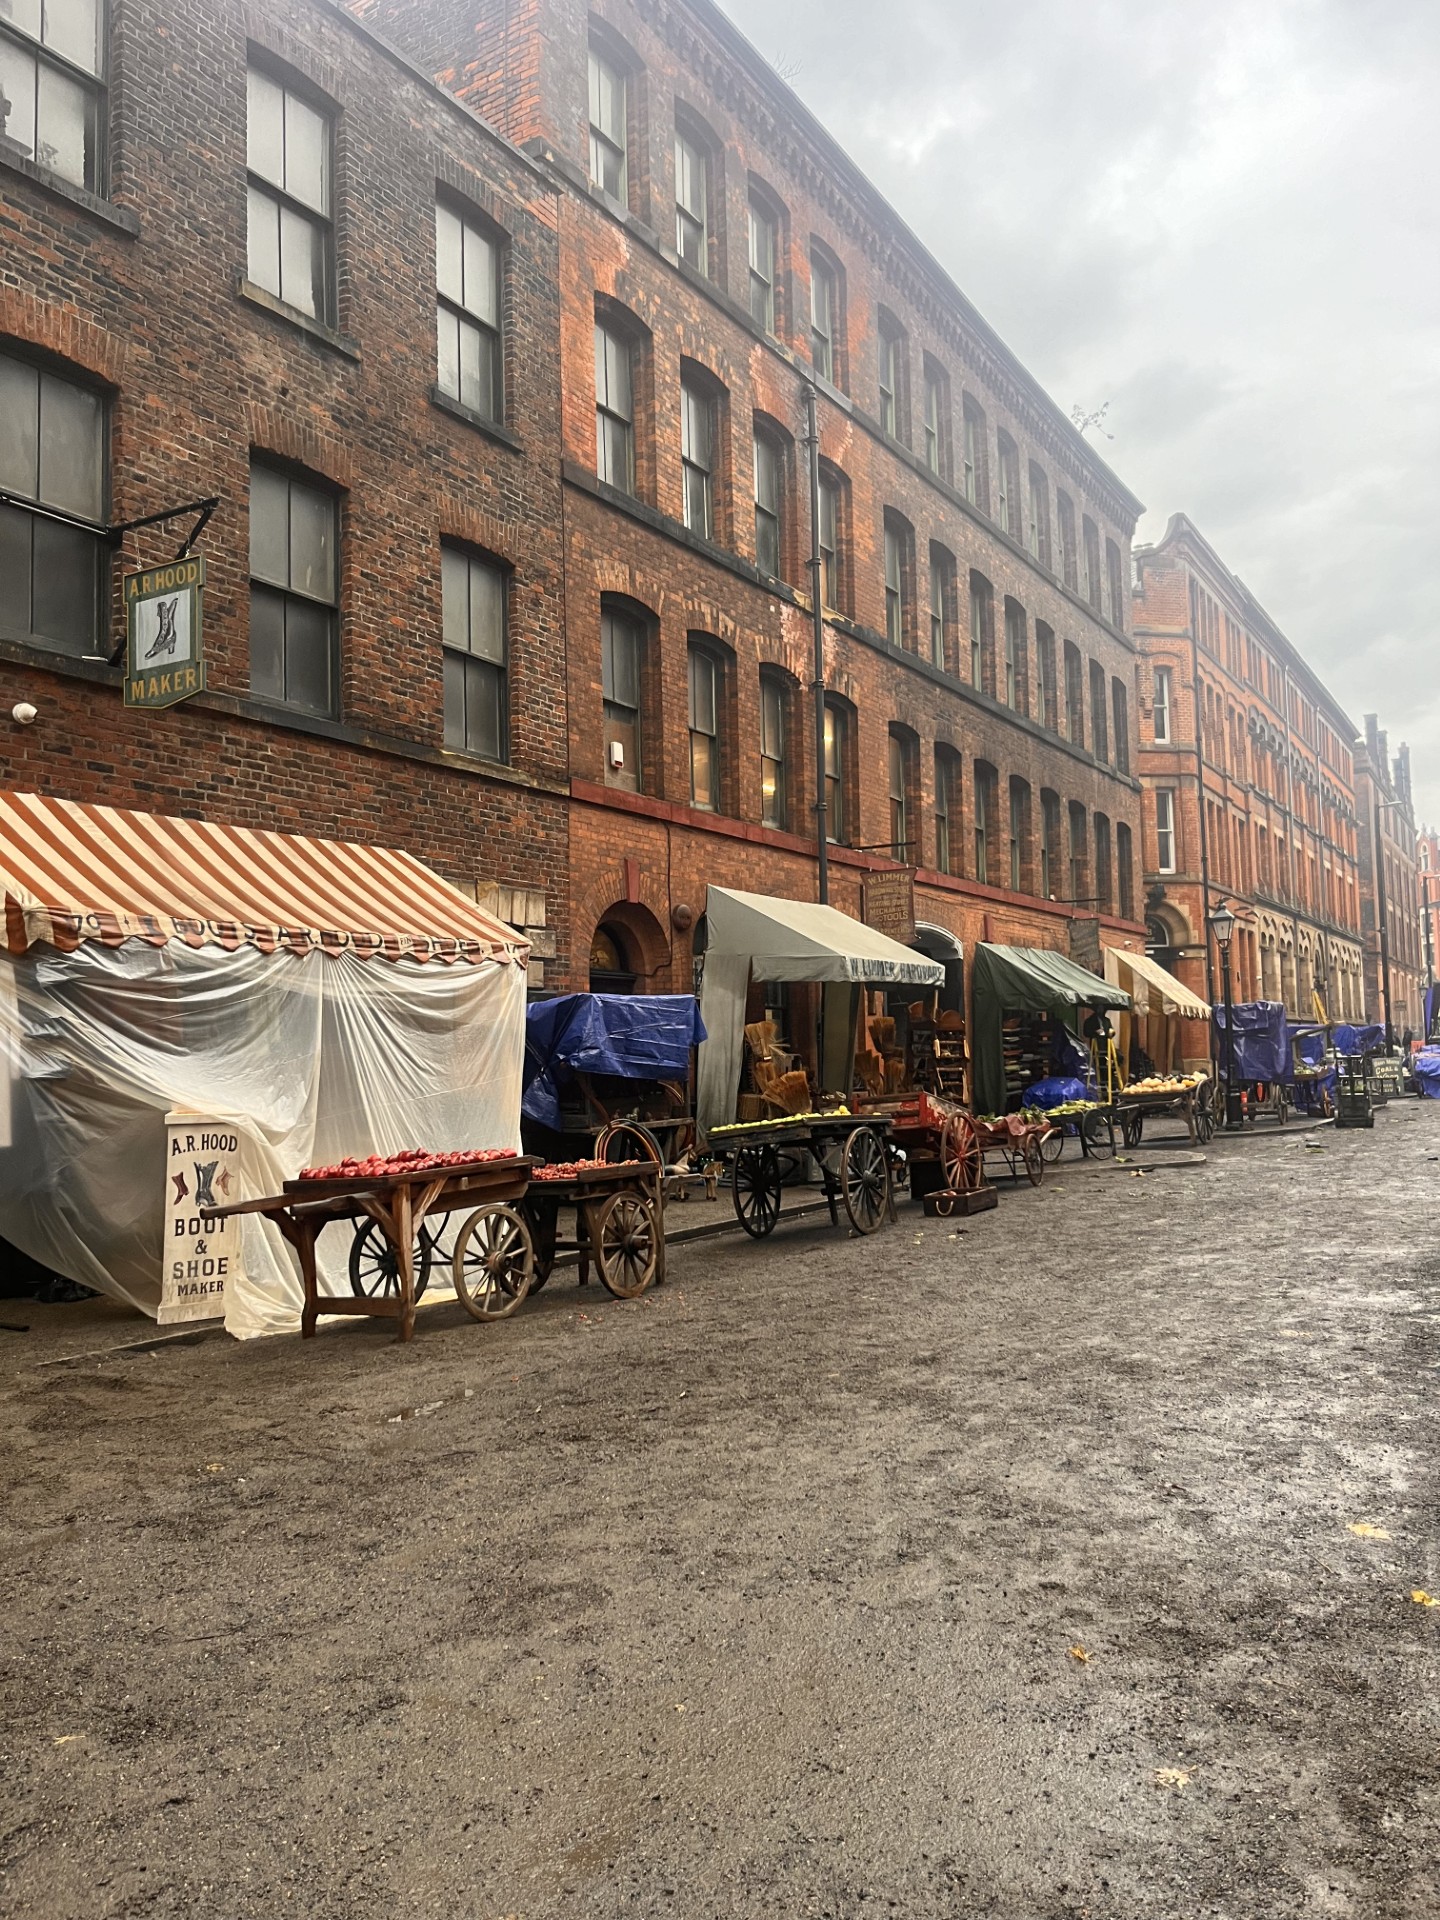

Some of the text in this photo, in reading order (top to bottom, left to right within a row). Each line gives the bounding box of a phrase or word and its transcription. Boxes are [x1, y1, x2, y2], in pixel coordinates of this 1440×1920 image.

[155, 562, 198, 589] HOOD
[131, 668, 196, 701] MAKER
[201, 1133, 238, 1152] HOOD
[174, 1216, 229, 1237] BOOT
[194, 1239, 208, 1255] &
[172, 1256, 229, 1280] SHOE
[177, 1280, 224, 1297] MAKER
